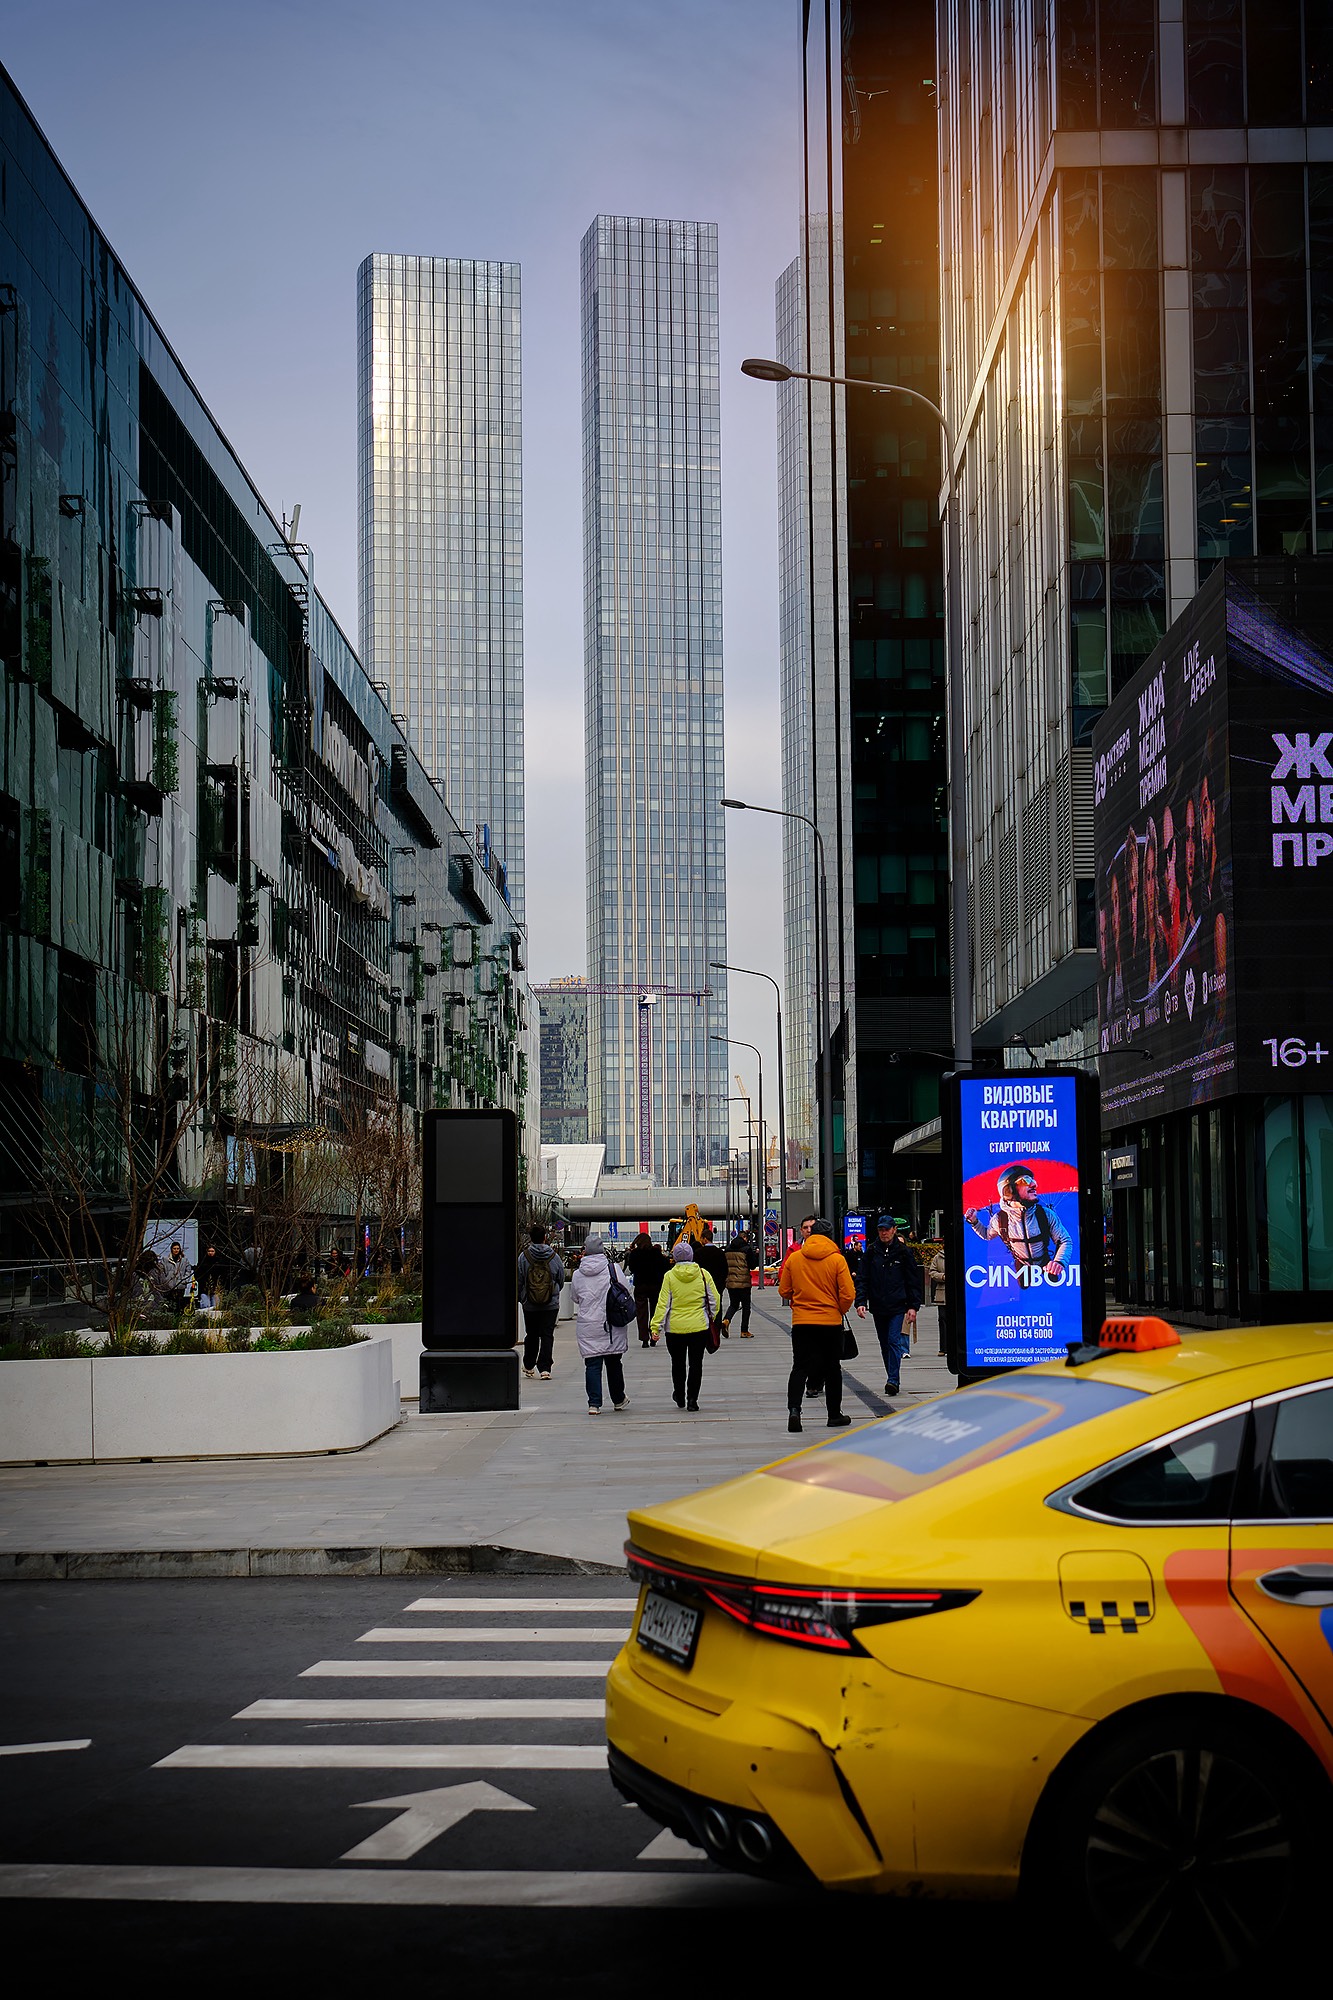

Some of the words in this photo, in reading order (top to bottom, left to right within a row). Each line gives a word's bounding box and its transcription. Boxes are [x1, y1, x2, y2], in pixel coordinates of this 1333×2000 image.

[1183, 639, 1200, 684] LIVE
[1189, 654, 1217, 708] АРЕНА
[1138, 669, 1166, 737] ЖАРА
[1138, 715, 1166, 774] МЕДИА
[1271, 732, 1333, 779] Ж
[1094, 753, 1107, 807] 29
[1106, 728, 1131, 772] ОКТЯБРЯ
[1139, 754, 1168, 810] ПРЕМИЯ
[1272, 832, 1333, 867] ПР
[1262, 1037, 1329, 1068] 16+
[983, 1084, 1054, 1106] ВИДОВЫЕ
[981, 1109, 1058, 1129] КВАРТИРЫ
[989, 1141, 1014, 1153] СТАРТ
[1015, 1140, 1051, 1153] ПРОДАЖ
[965, 1264, 1081, 1288] СИМВОЛ
[995, 1312, 1053, 1327] ДОНСТРОЙ
[996, 1329, 1017, 1339] (495)
[1018, 1329, 1033, 1339] 154
[1033, 1328, 1053, 1339] 5000
